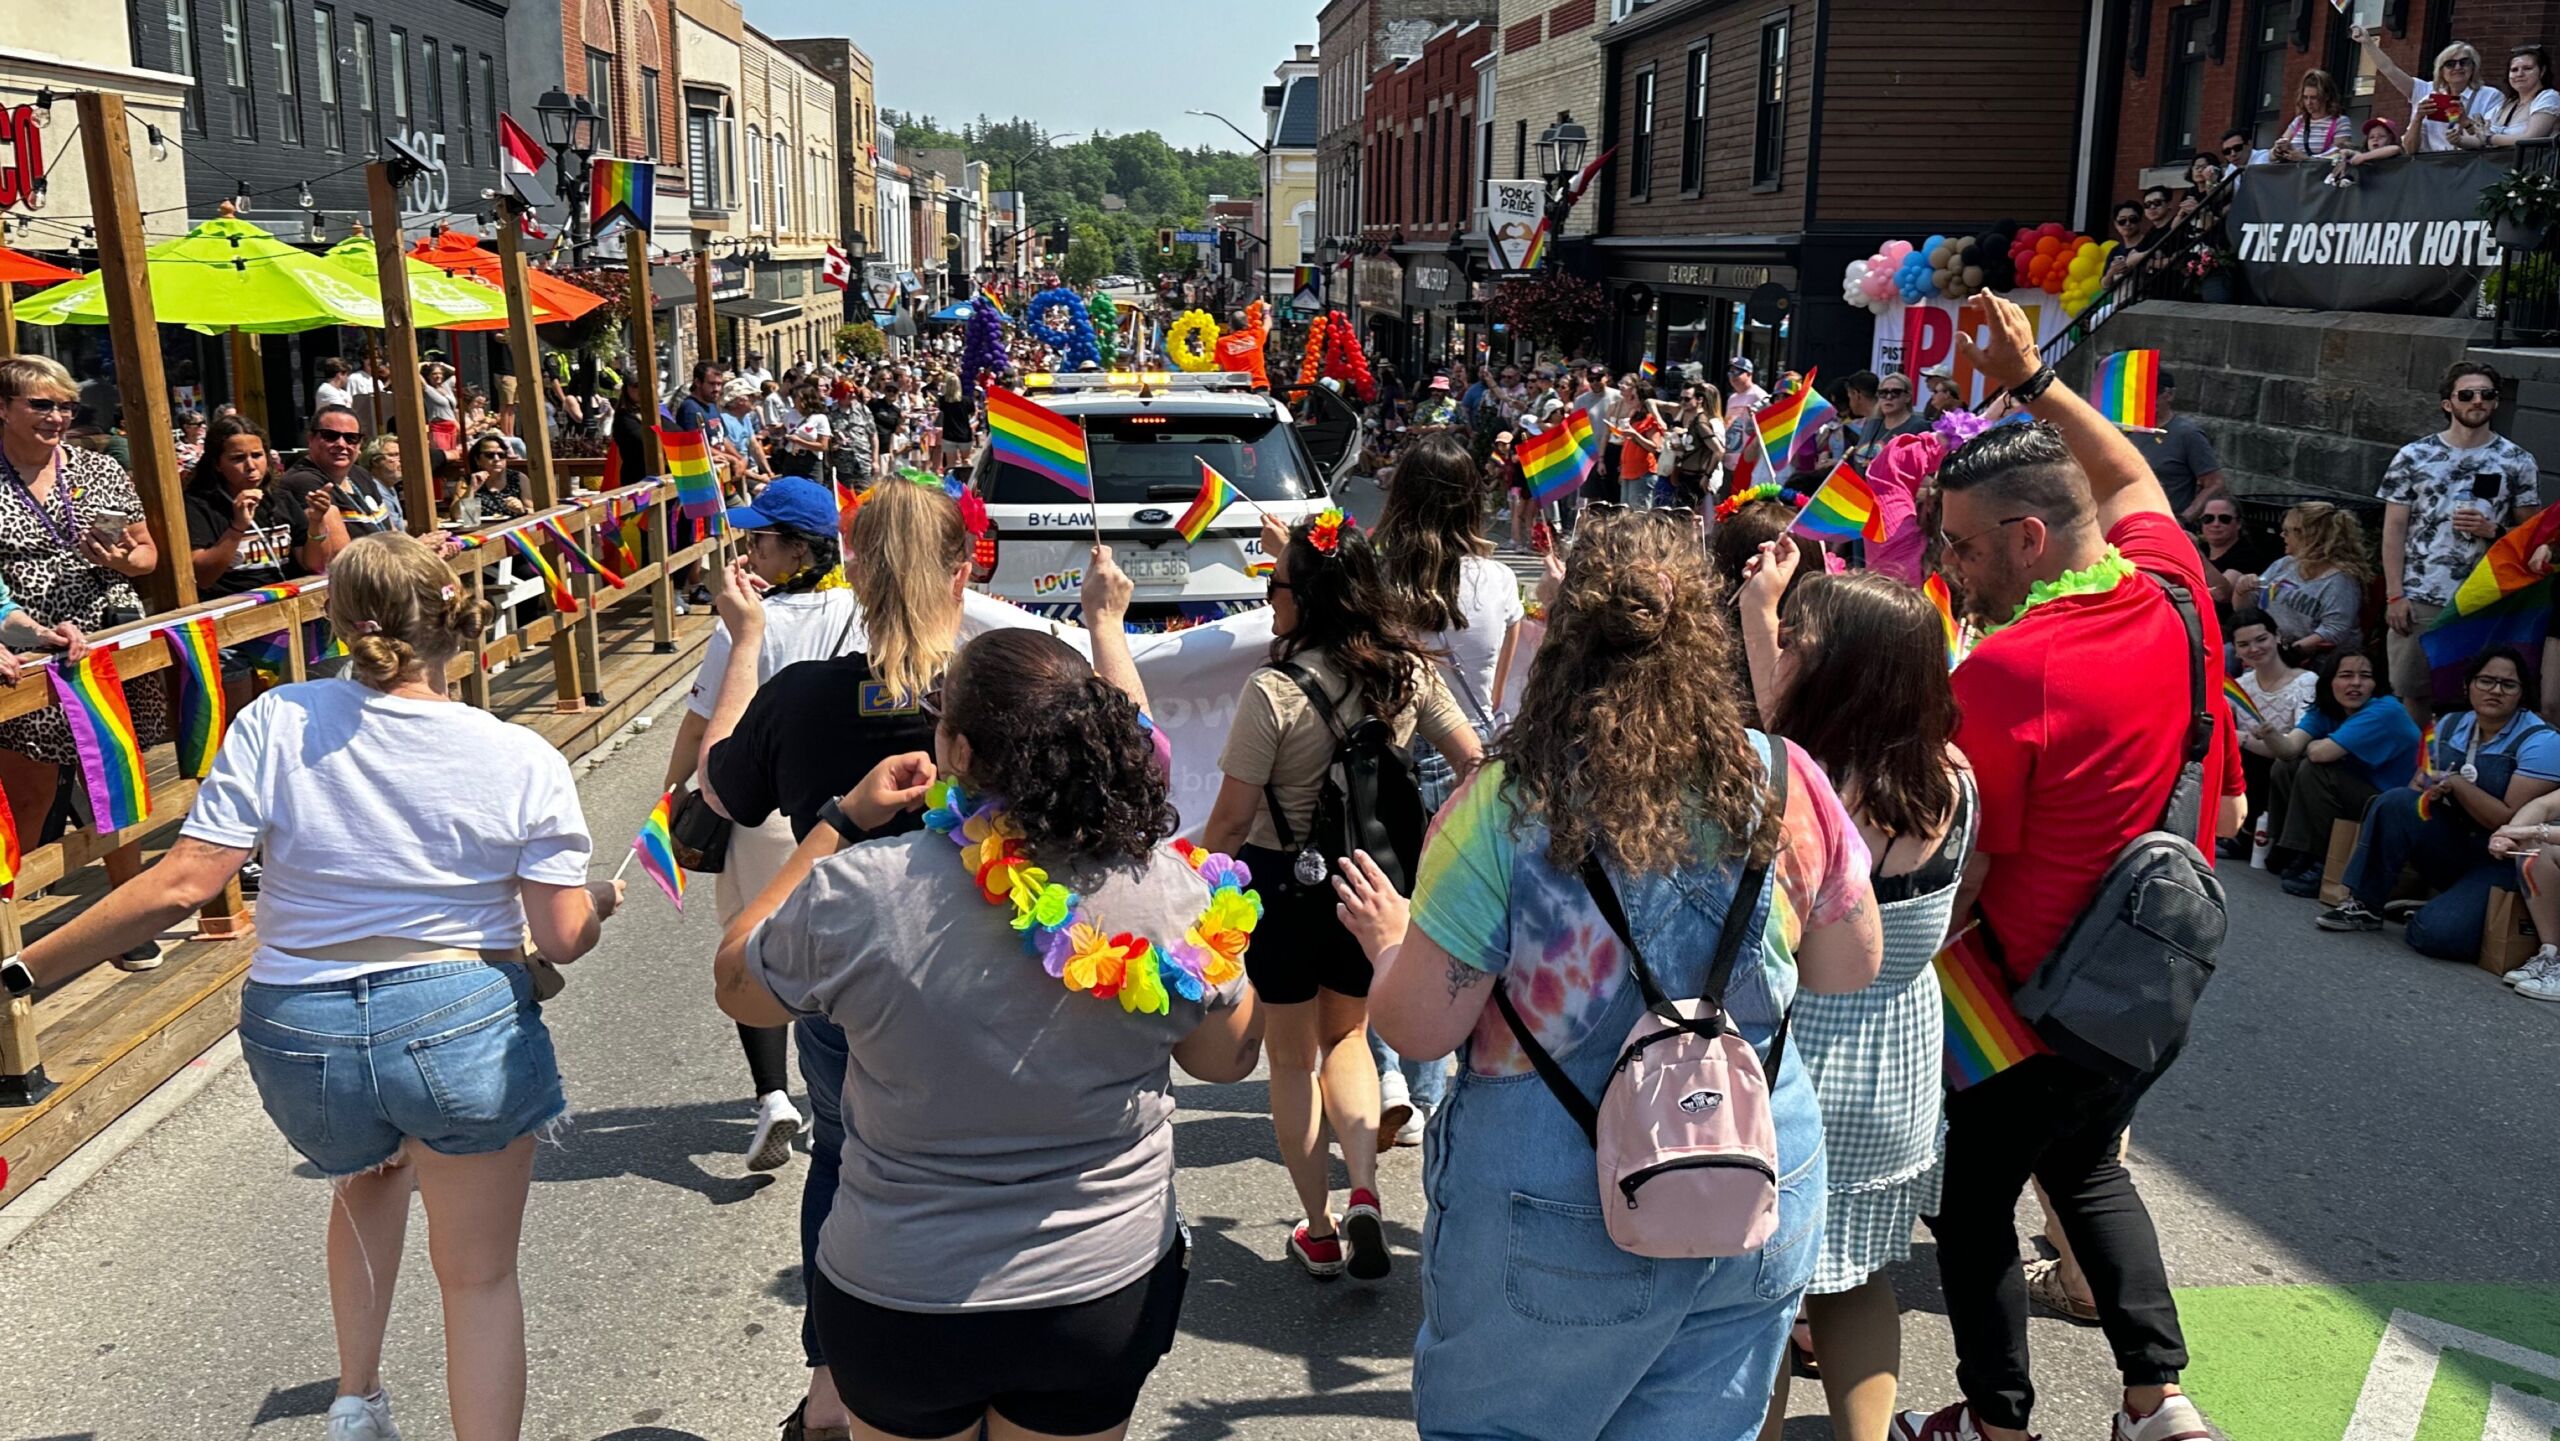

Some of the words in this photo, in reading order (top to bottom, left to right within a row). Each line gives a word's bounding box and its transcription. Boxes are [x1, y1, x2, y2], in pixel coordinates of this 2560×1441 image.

[1499, 185, 1532, 201] YORK
[1501, 198, 1535, 213] PRIDE
[2238, 223, 2284, 262] THE
[2282, 222, 2420, 265] POSTMARK
[1028, 512, 1096, 526] BY-LAW
[1141, 510, 1165, 522] Ford
[1162, 559, 1186, 576] 586
[1034, 568, 1082, 595] LOVE
